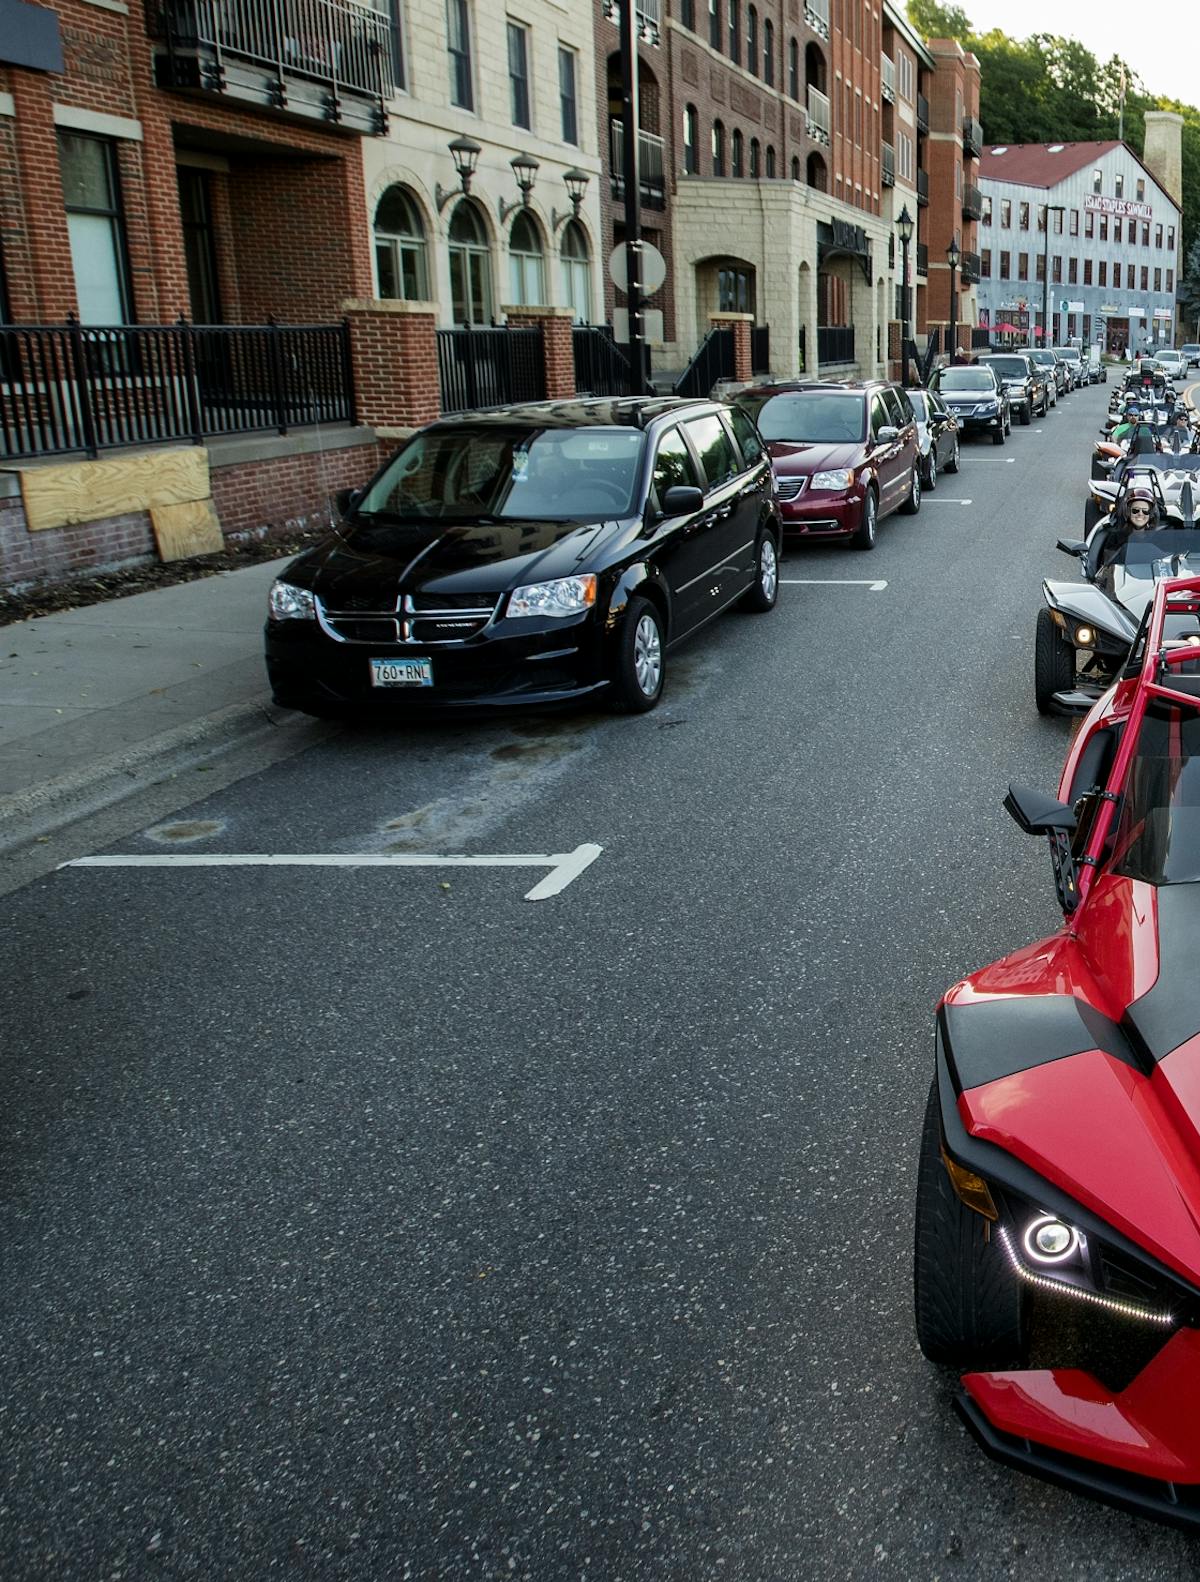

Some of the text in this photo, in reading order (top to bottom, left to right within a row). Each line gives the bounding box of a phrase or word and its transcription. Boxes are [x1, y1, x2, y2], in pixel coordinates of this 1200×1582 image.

[1085, 195, 1152, 219] ISAAC STAPLES SAWMILL
[374, 665, 429, 680] 760 RNL
